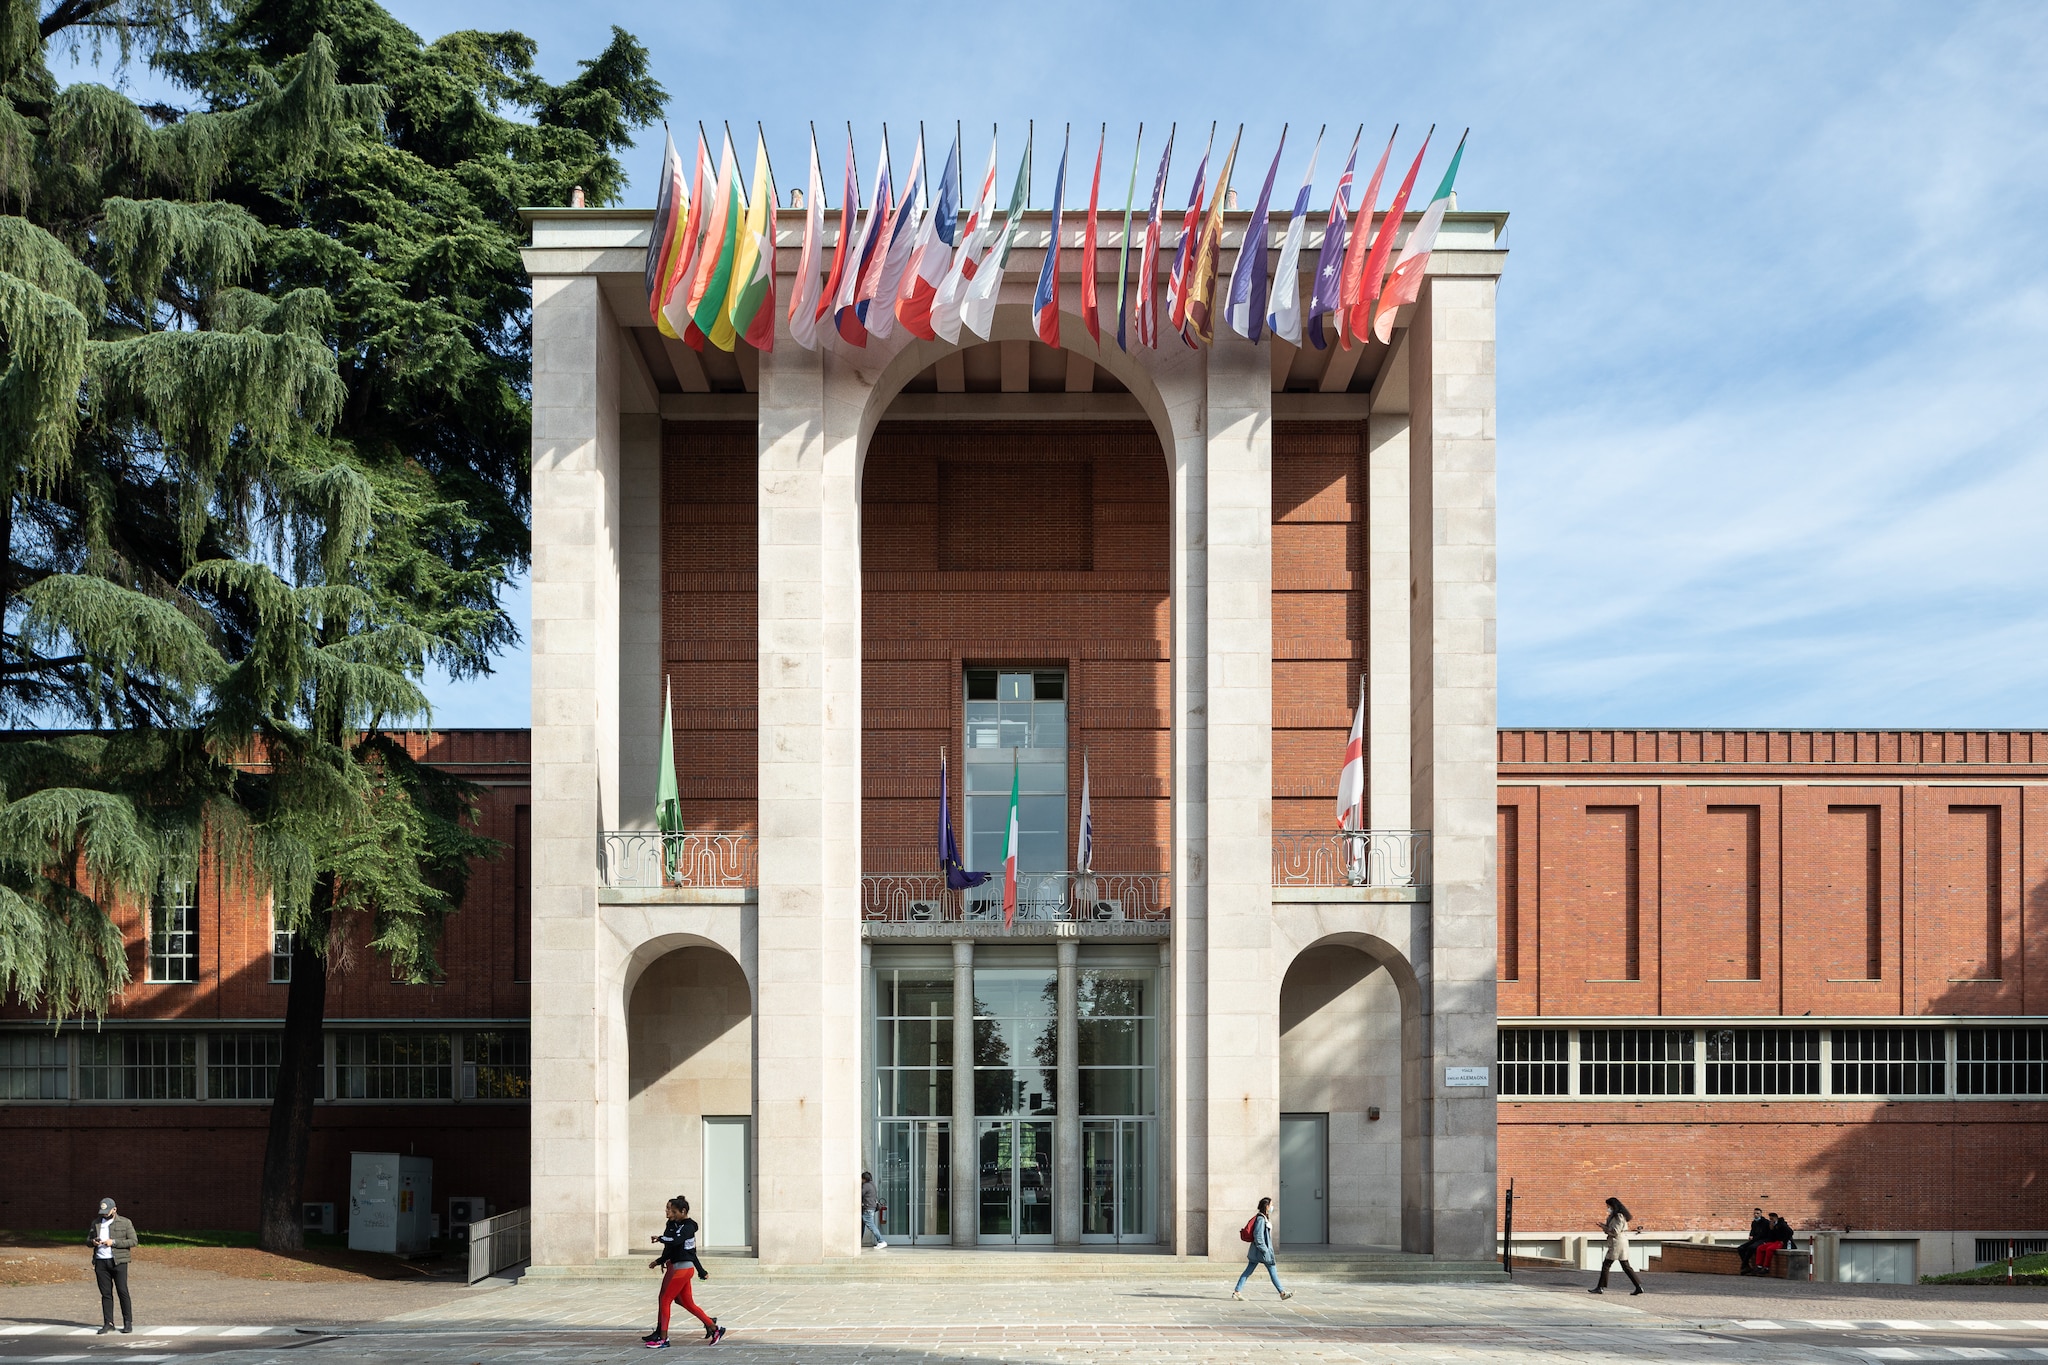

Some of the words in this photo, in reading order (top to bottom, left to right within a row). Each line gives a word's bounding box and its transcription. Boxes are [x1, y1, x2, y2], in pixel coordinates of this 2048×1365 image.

[861, 924, 918, 937] ALAZZO
[926, 923, 998, 936] DELL'ARTE
[1010, 923, 1096, 937] FONDAZIONE
[1103, 922, 1170, 936] BERNOCC
